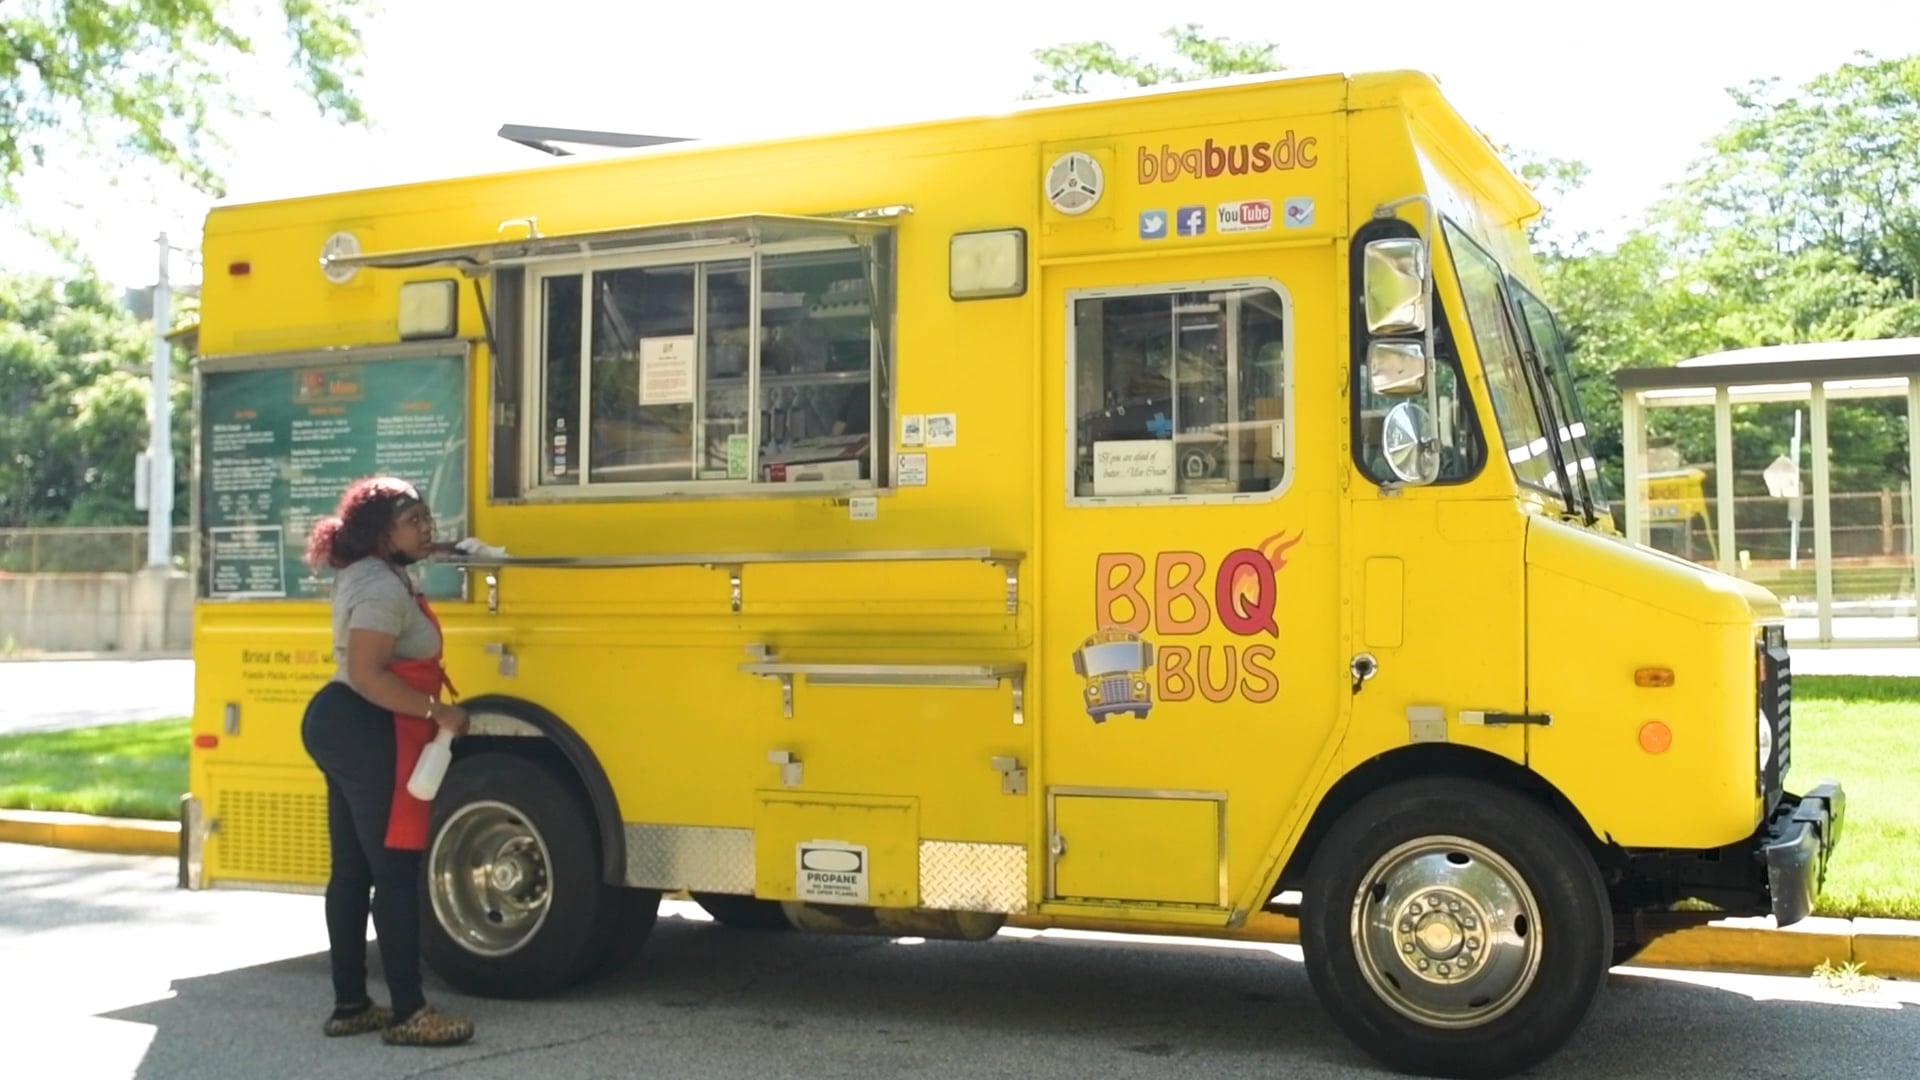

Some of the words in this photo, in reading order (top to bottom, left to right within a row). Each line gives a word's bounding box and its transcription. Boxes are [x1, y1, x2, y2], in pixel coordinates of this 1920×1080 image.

[1138, 130, 1317, 184] bbqbusdc
[1095, 548, 1279, 639] BBQ
[1157, 644, 1279, 703] BUS
[807, 872, 857, 884] PROPANE
